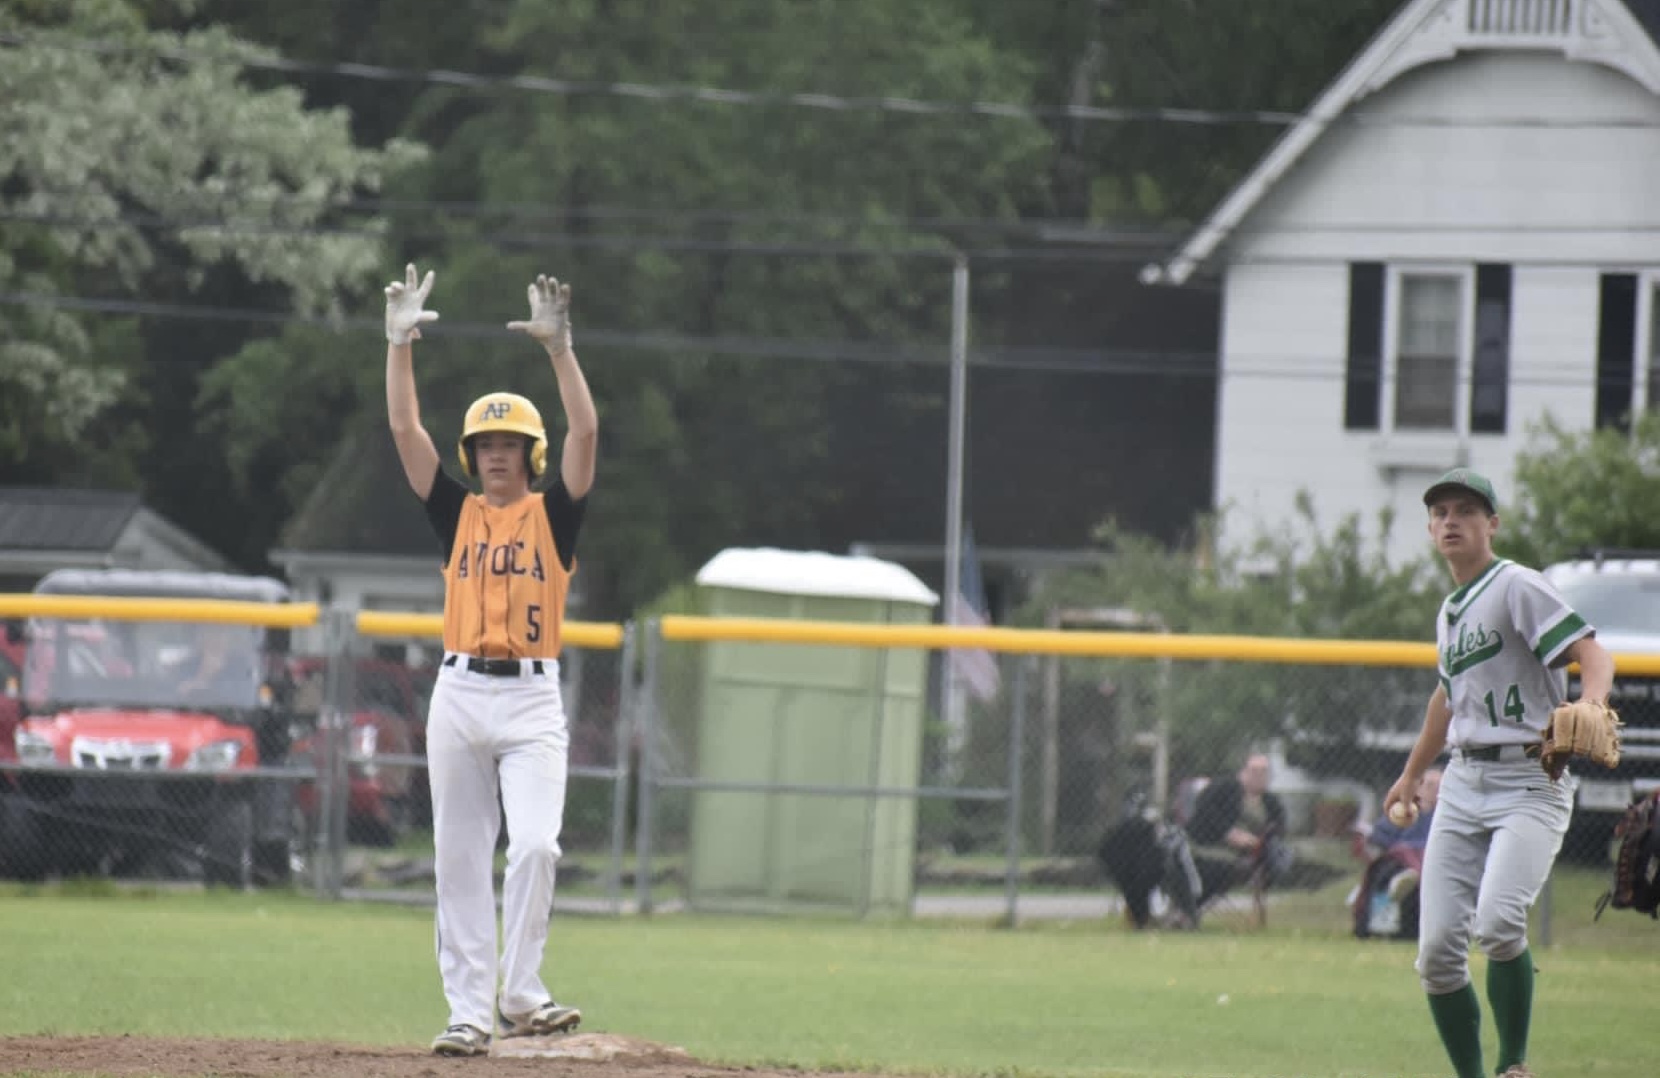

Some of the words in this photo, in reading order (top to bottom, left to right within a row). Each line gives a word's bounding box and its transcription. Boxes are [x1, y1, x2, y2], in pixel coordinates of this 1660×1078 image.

[480, 402, 511, 422] AP
[526, 604, 541, 643] 5
[1484, 684, 1525, 727] 14
